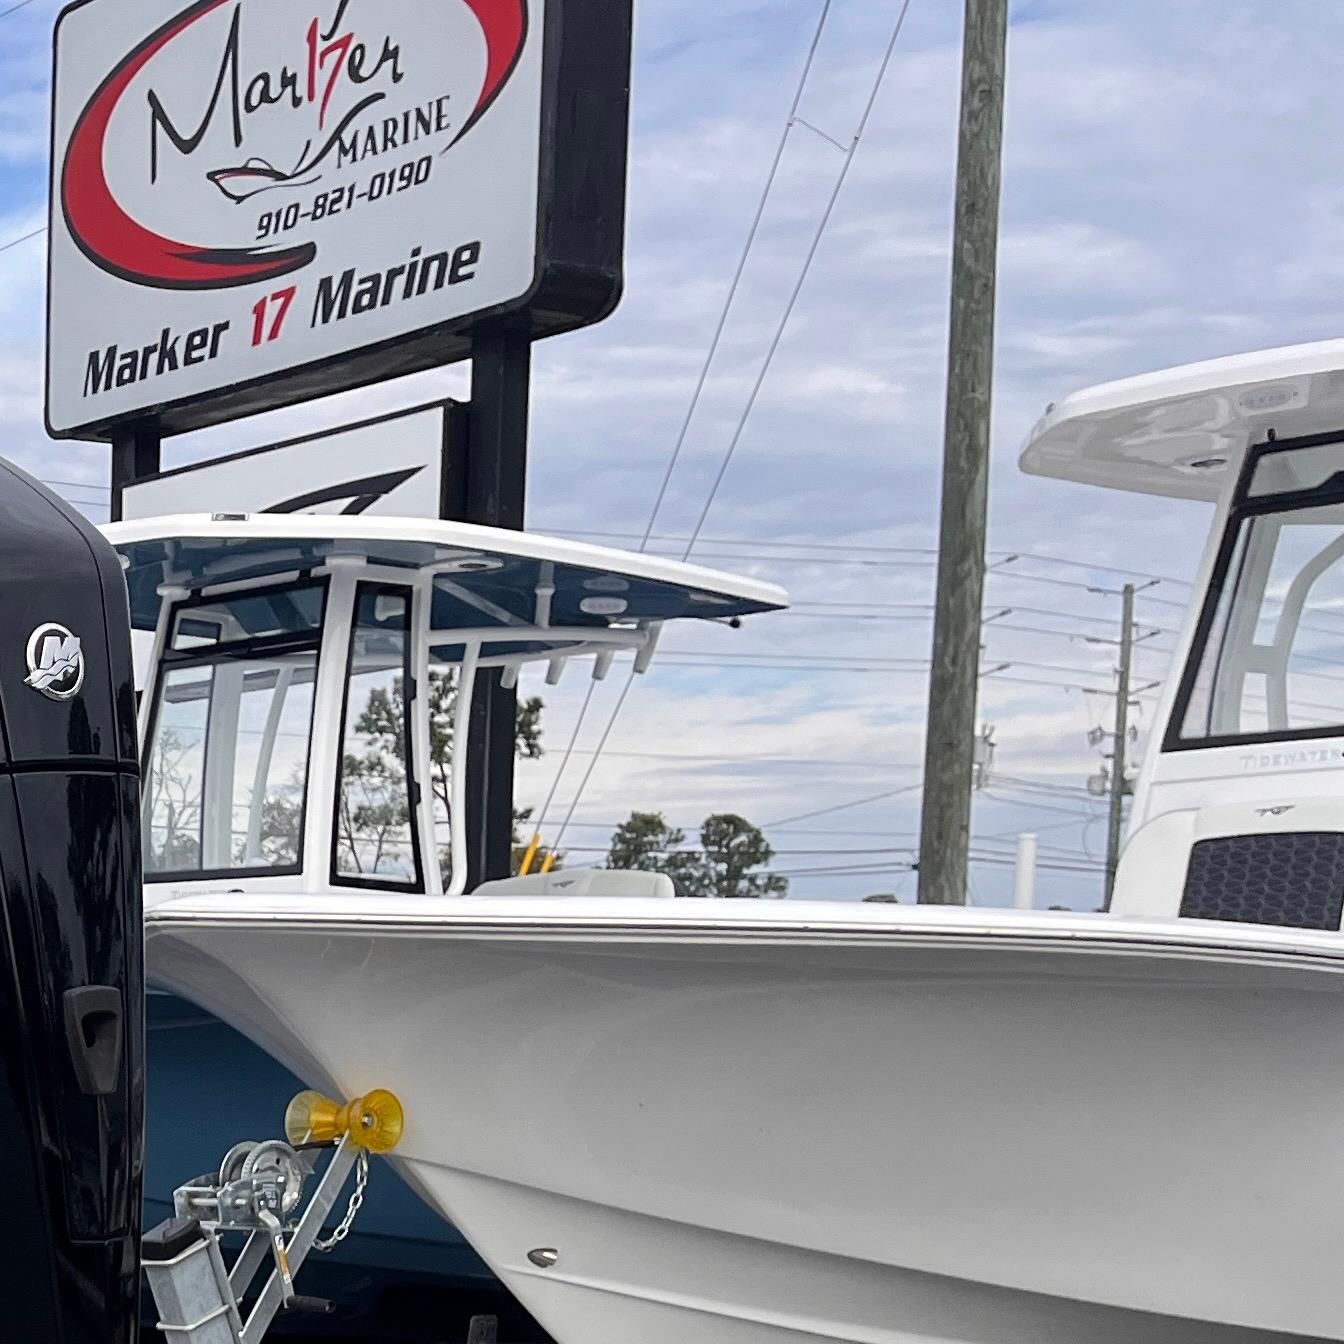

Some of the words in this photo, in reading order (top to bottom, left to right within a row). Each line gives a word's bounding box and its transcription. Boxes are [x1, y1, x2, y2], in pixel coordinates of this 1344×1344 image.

[337, 95, 451, 169] MARINE
[256, 155, 433, 240] 910-821-0190
[83, 320, 230, 398] Marker
[251, 285, 297, 347] 17
[310, 241, 481, 328] Marine
